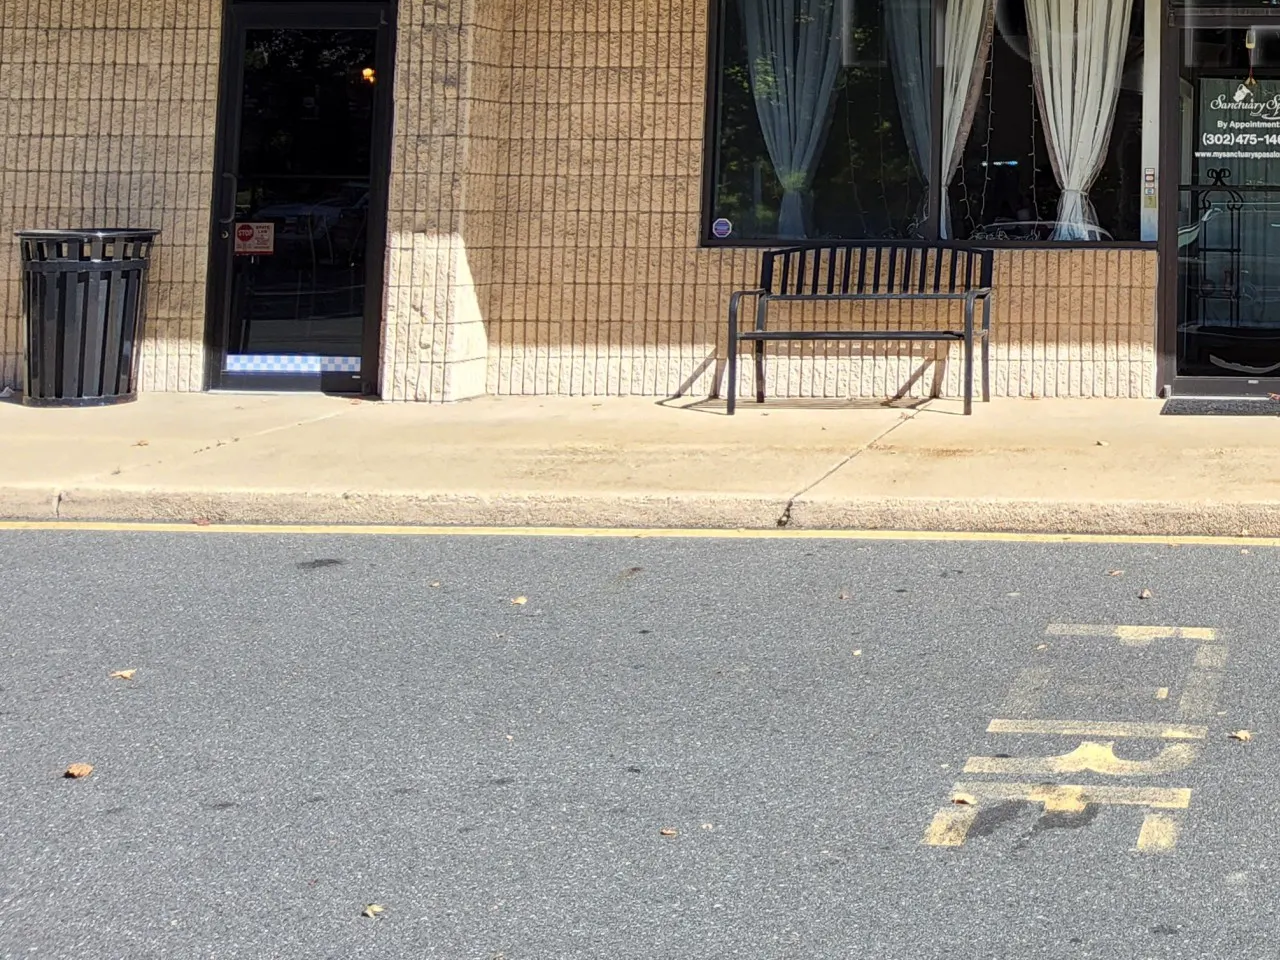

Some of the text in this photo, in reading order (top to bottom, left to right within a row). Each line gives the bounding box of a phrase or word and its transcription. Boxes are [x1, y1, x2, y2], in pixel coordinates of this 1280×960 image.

[1210, 94, 1266, 114] Sanctuary
[1217, 121, 1227, 129] By
[238, 229, 253, 237] STOP
